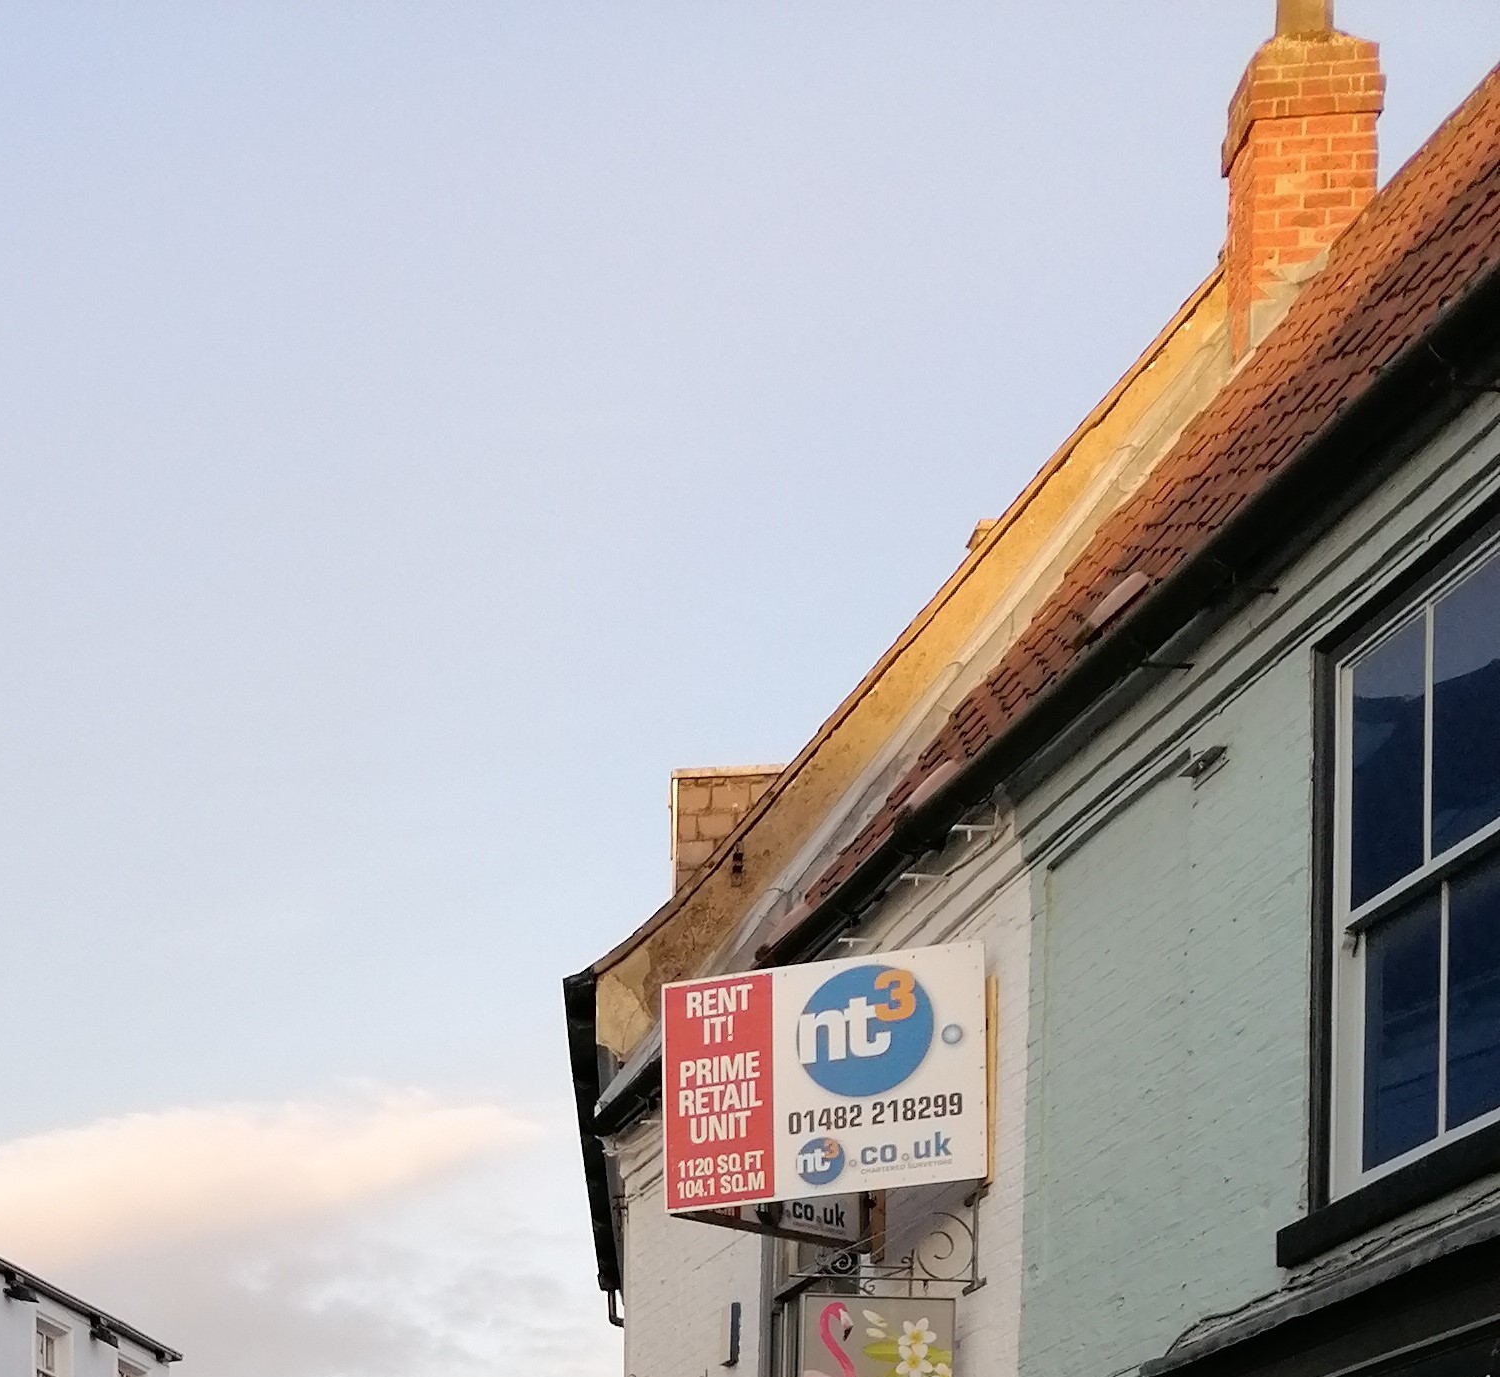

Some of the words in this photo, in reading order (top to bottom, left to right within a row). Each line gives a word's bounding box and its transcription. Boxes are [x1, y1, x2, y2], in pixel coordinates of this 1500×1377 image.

[686, 983, 754, 1019] RENT
[702, 1015, 734, 1045] IT!
[679, 1050, 761, 1088] PRIME
[678, 1081, 763, 1117] RETAIL
[788, 1104, 863, 1136] 01482
[871, 1092, 964, 1126] 218299
[690, 1111, 752, 1144] UNIT
[677, 1156, 713, 1179] 1120
[717, 1153, 742, 1175] SQ
[744, 1150, 765, 1170] FT
[676, 1177, 716, 1199] 104.1
